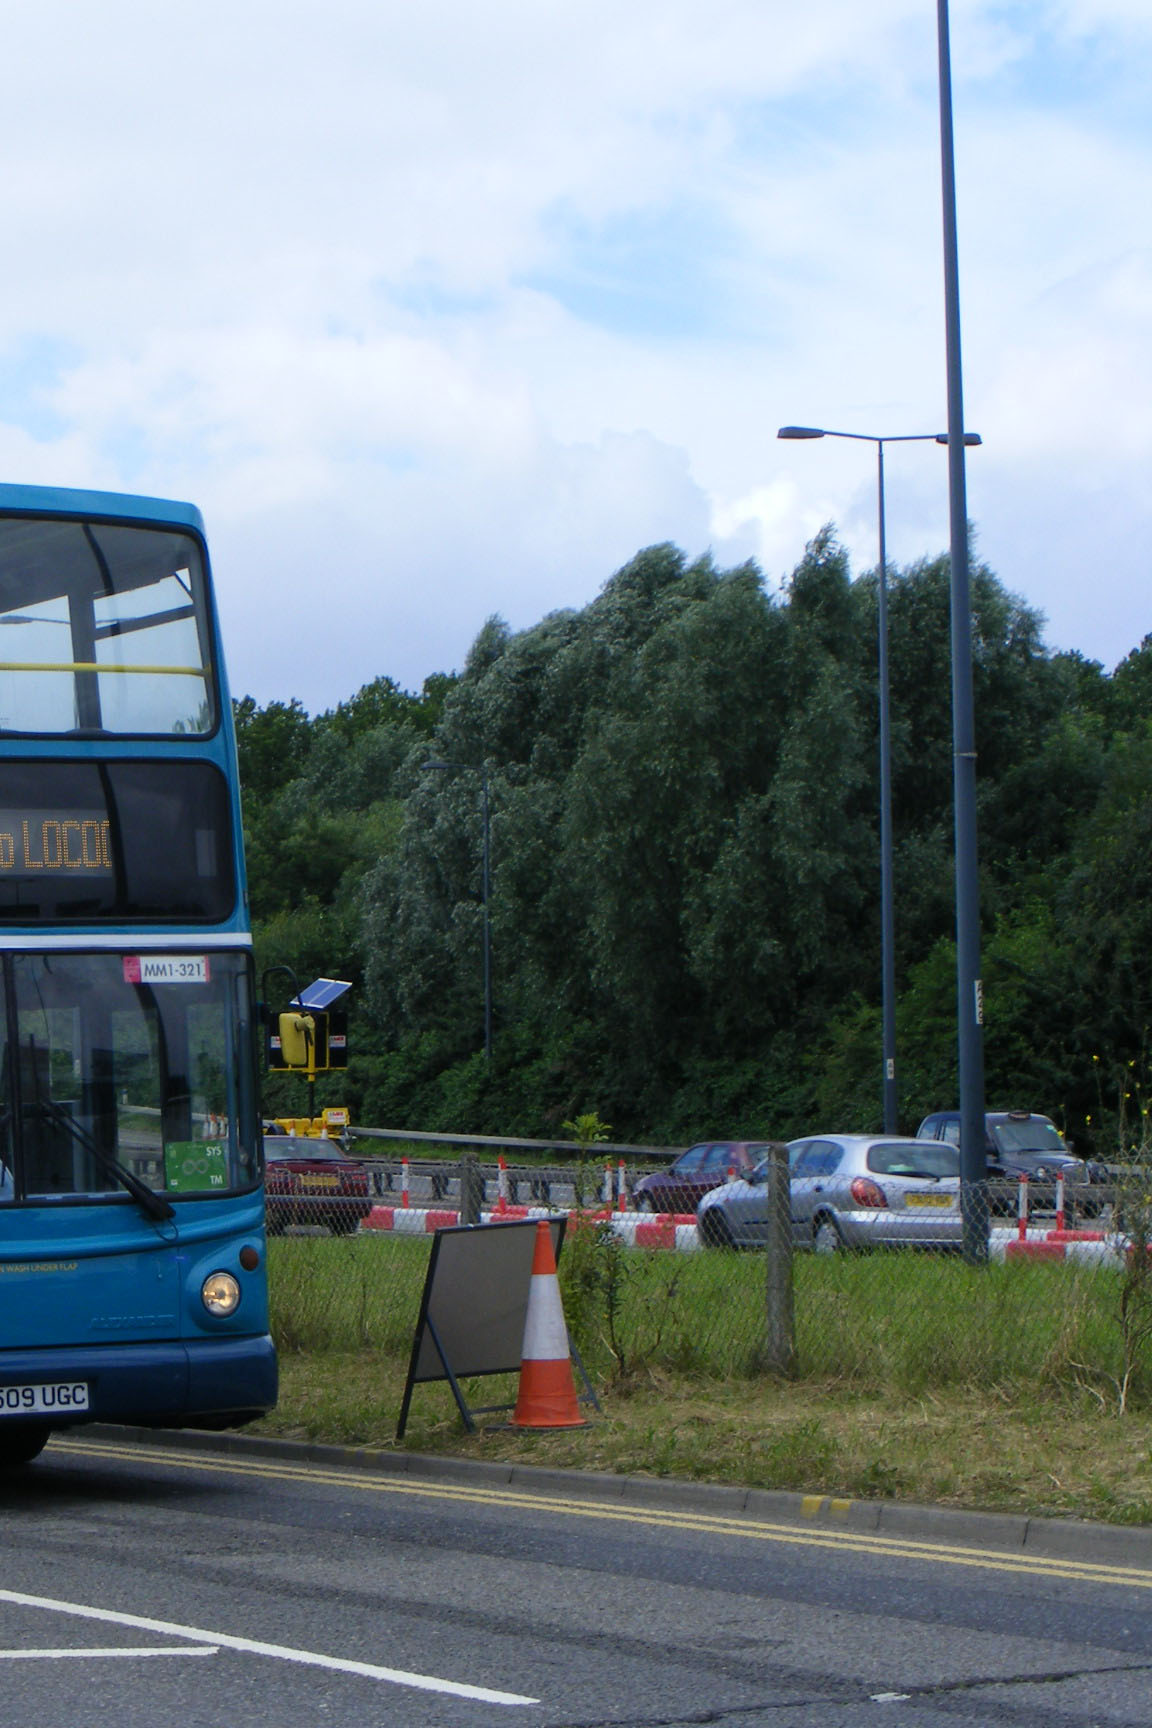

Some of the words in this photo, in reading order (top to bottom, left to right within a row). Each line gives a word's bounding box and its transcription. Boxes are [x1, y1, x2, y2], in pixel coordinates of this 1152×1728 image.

[206, 1146, 222, 1157] SYS
[210, 1174, 223, 1185] TM
[7, 1264, 30, 1273] WASH
[31, 1263, 59, 1272] UNDER
[60, 1263, 78, 1271] FLAP
[42, 1384, 86, 1407] UGC
